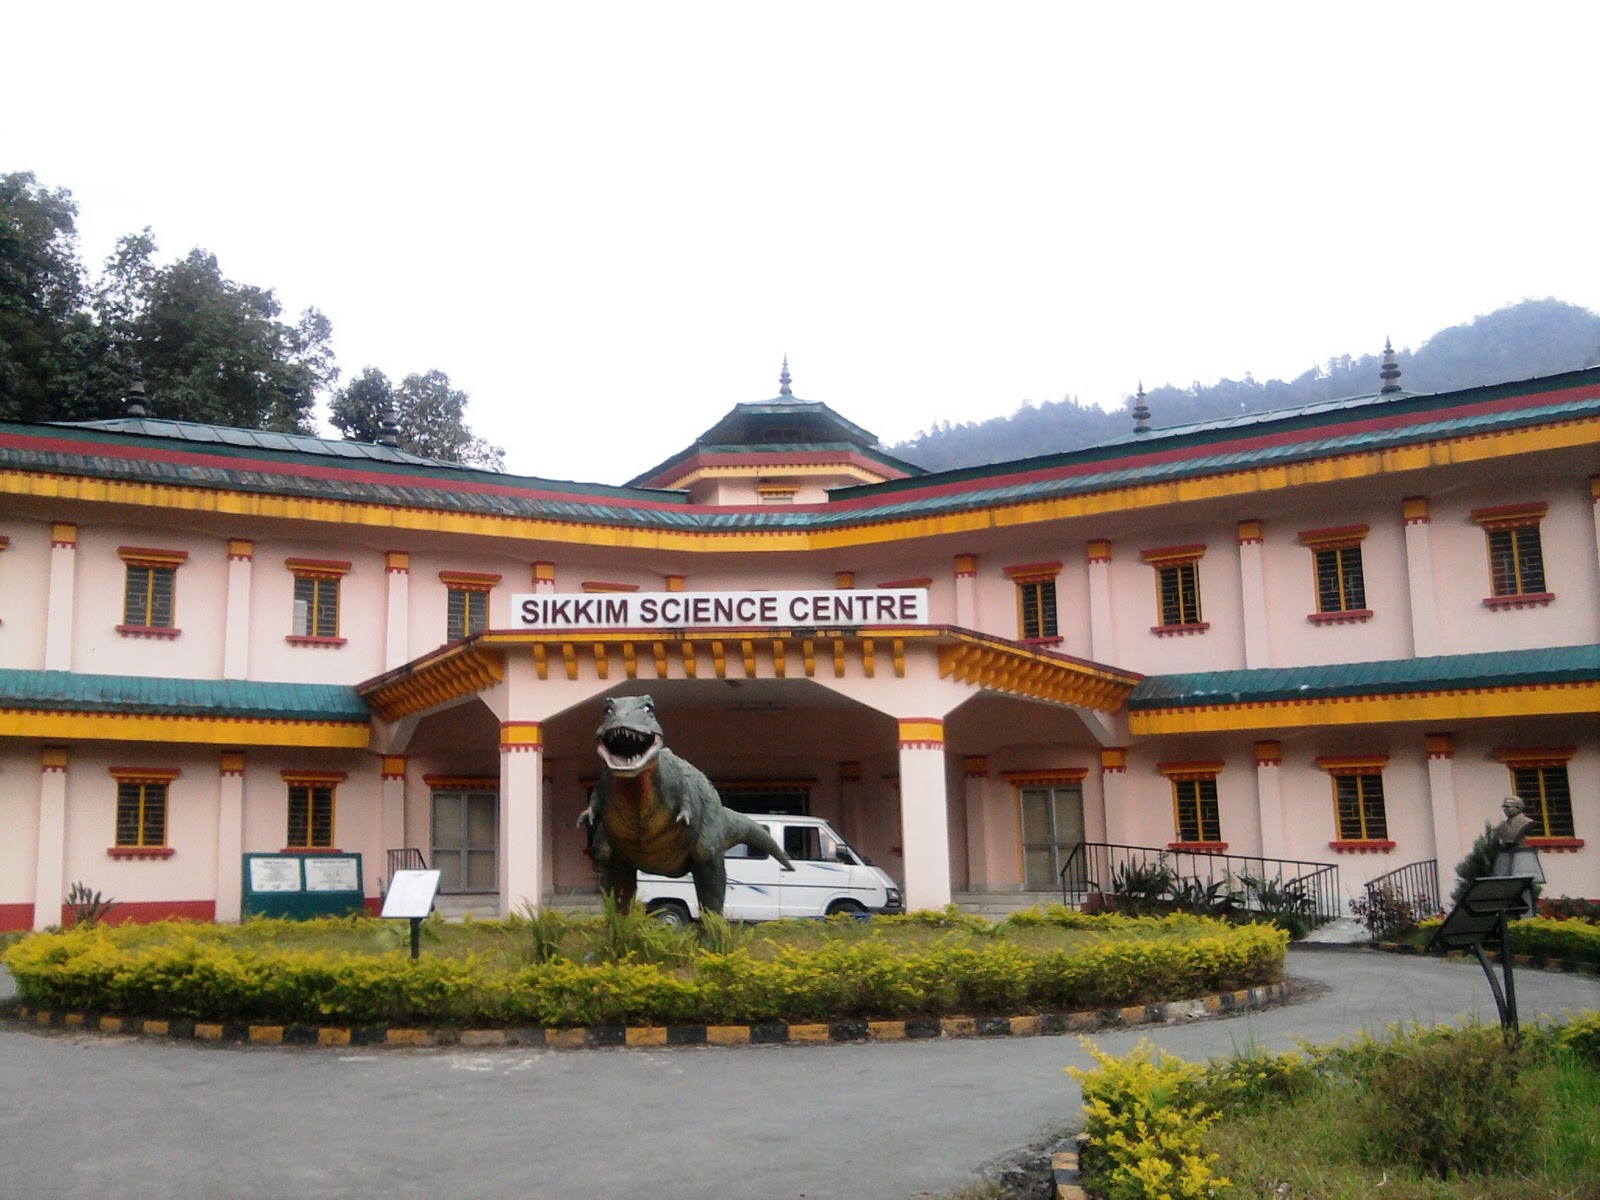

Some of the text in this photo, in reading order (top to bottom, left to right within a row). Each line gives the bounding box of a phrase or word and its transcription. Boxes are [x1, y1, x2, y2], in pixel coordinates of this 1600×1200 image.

[521, 595, 919, 625] SIKKIM SCIENCE CENTRE
